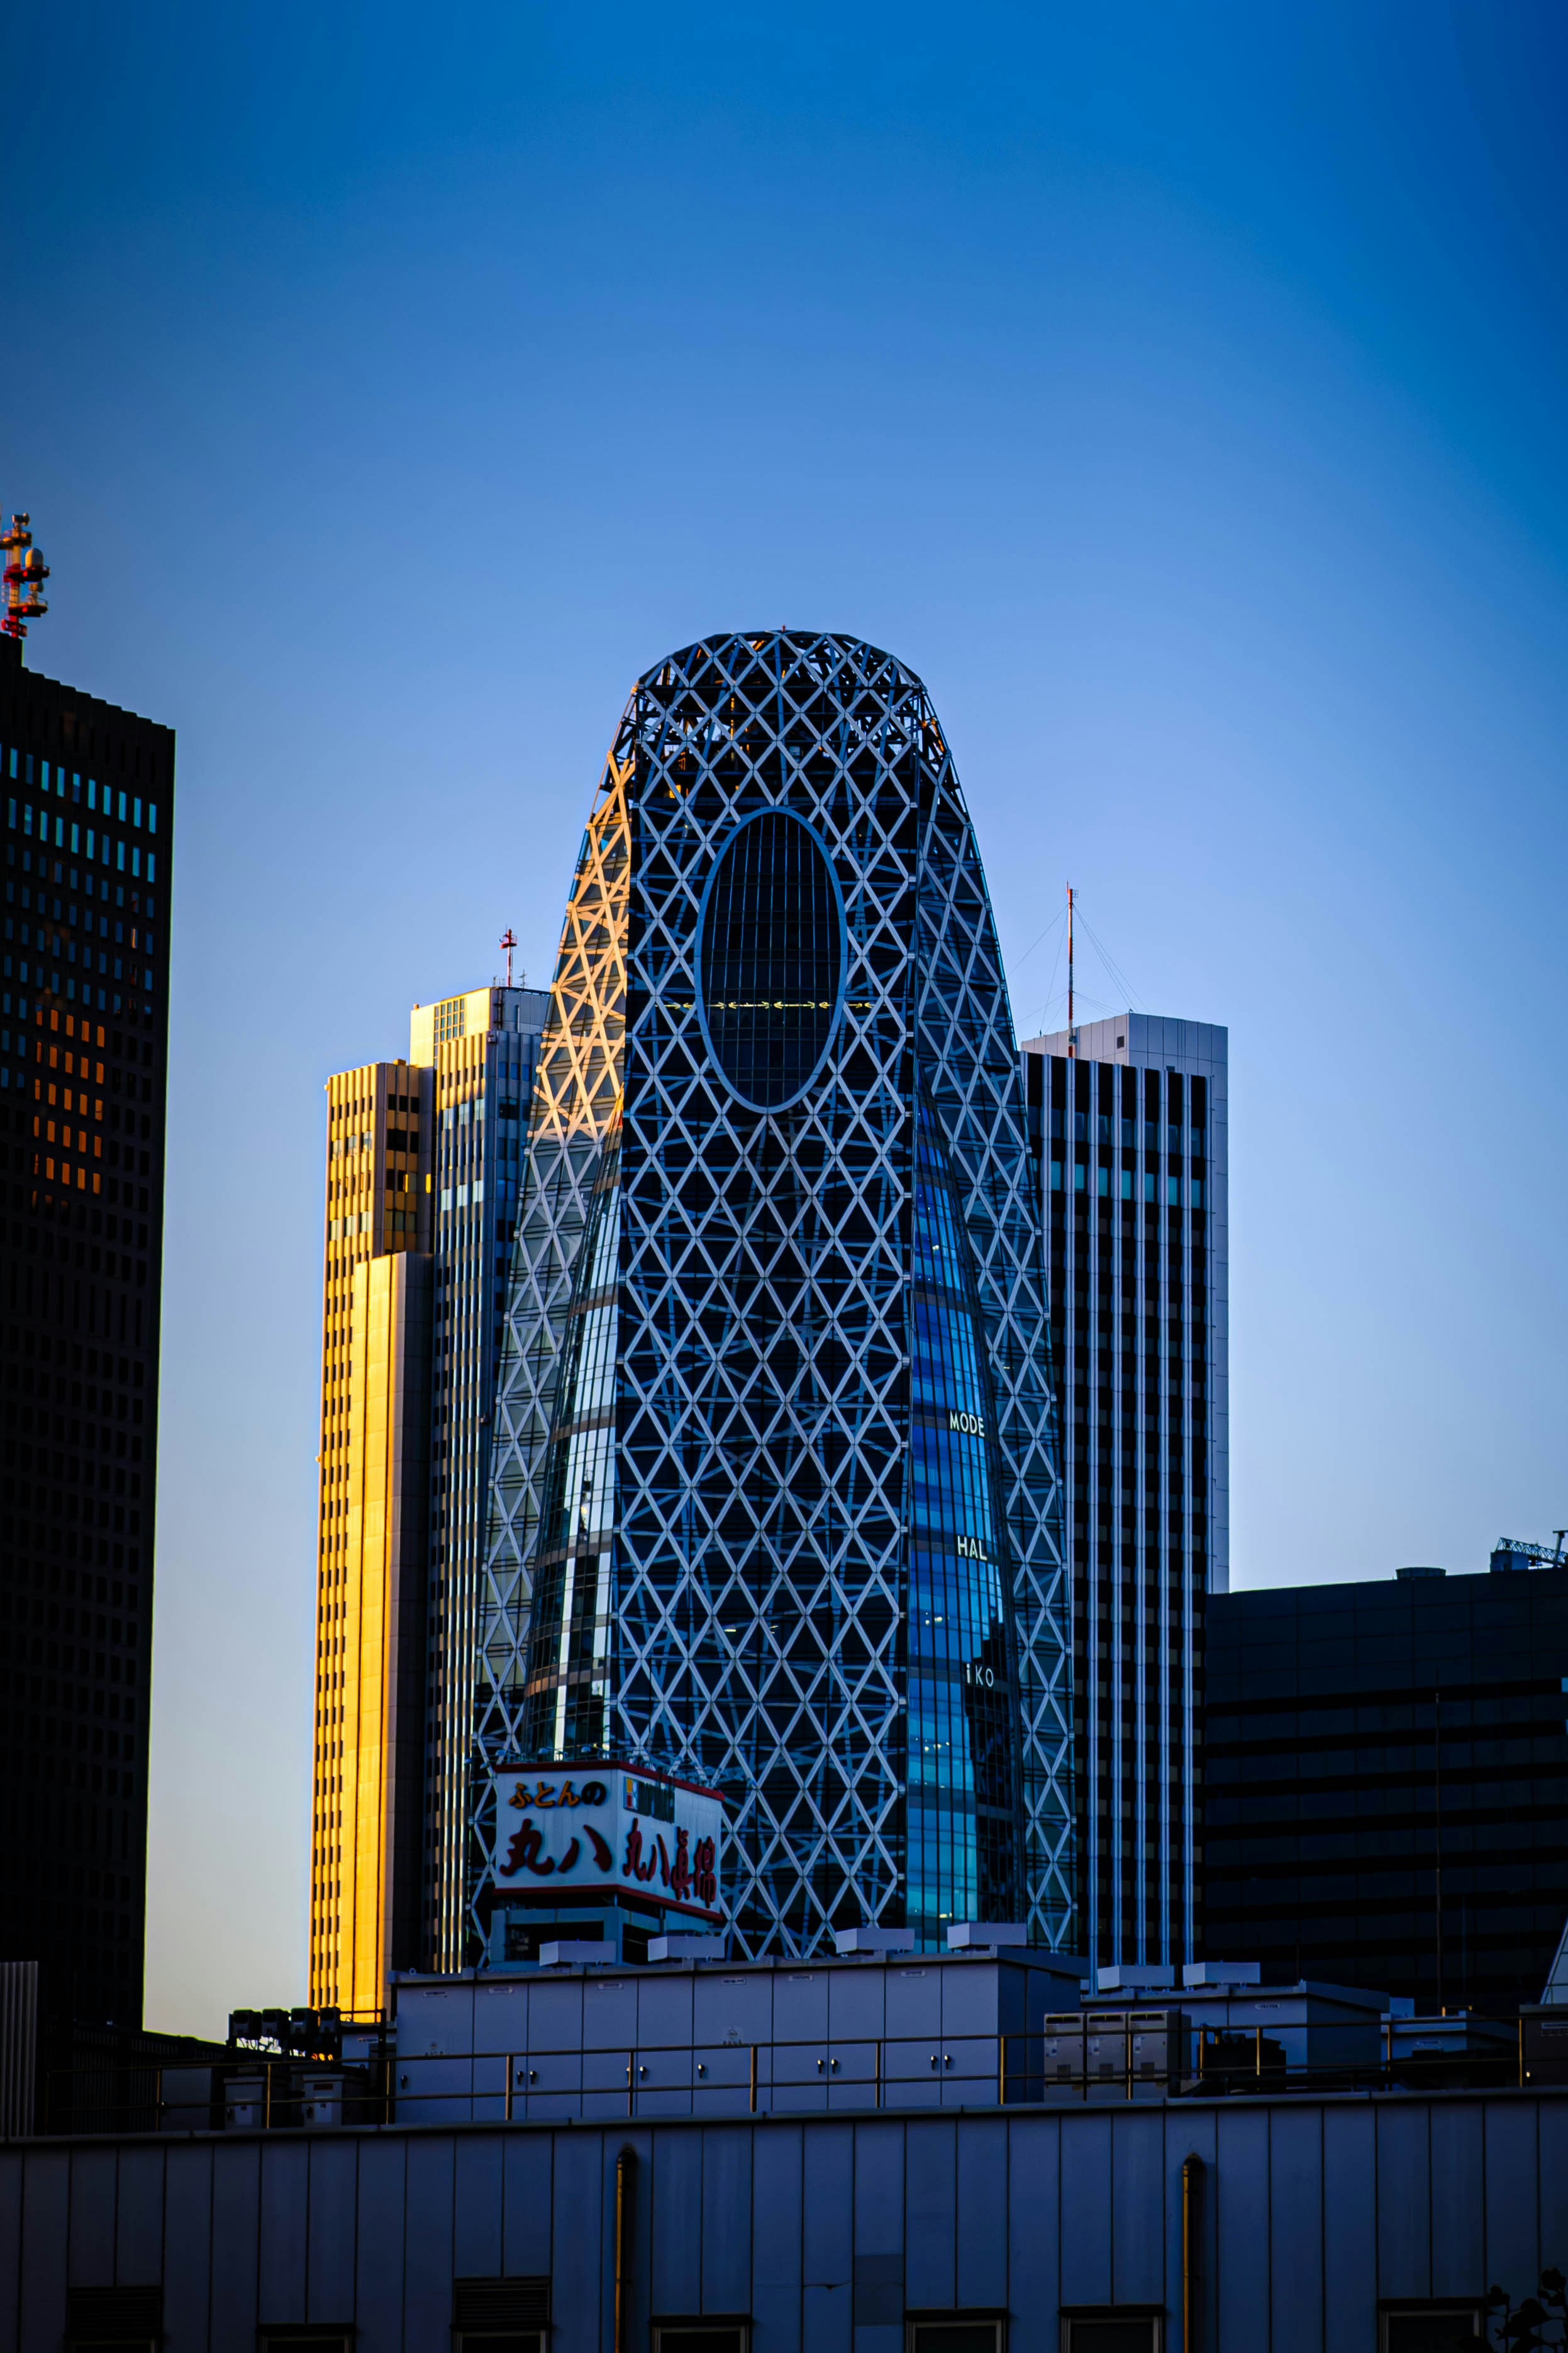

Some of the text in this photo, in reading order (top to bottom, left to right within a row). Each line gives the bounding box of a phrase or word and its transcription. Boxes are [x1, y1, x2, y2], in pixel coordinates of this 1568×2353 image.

[950, 1410, 985, 1438] MODE
[957, 1535, 987, 1560] HAL
[508, 1780, 606, 1809] ふとんの
[499, 1818, 612, 1876] 丸八
